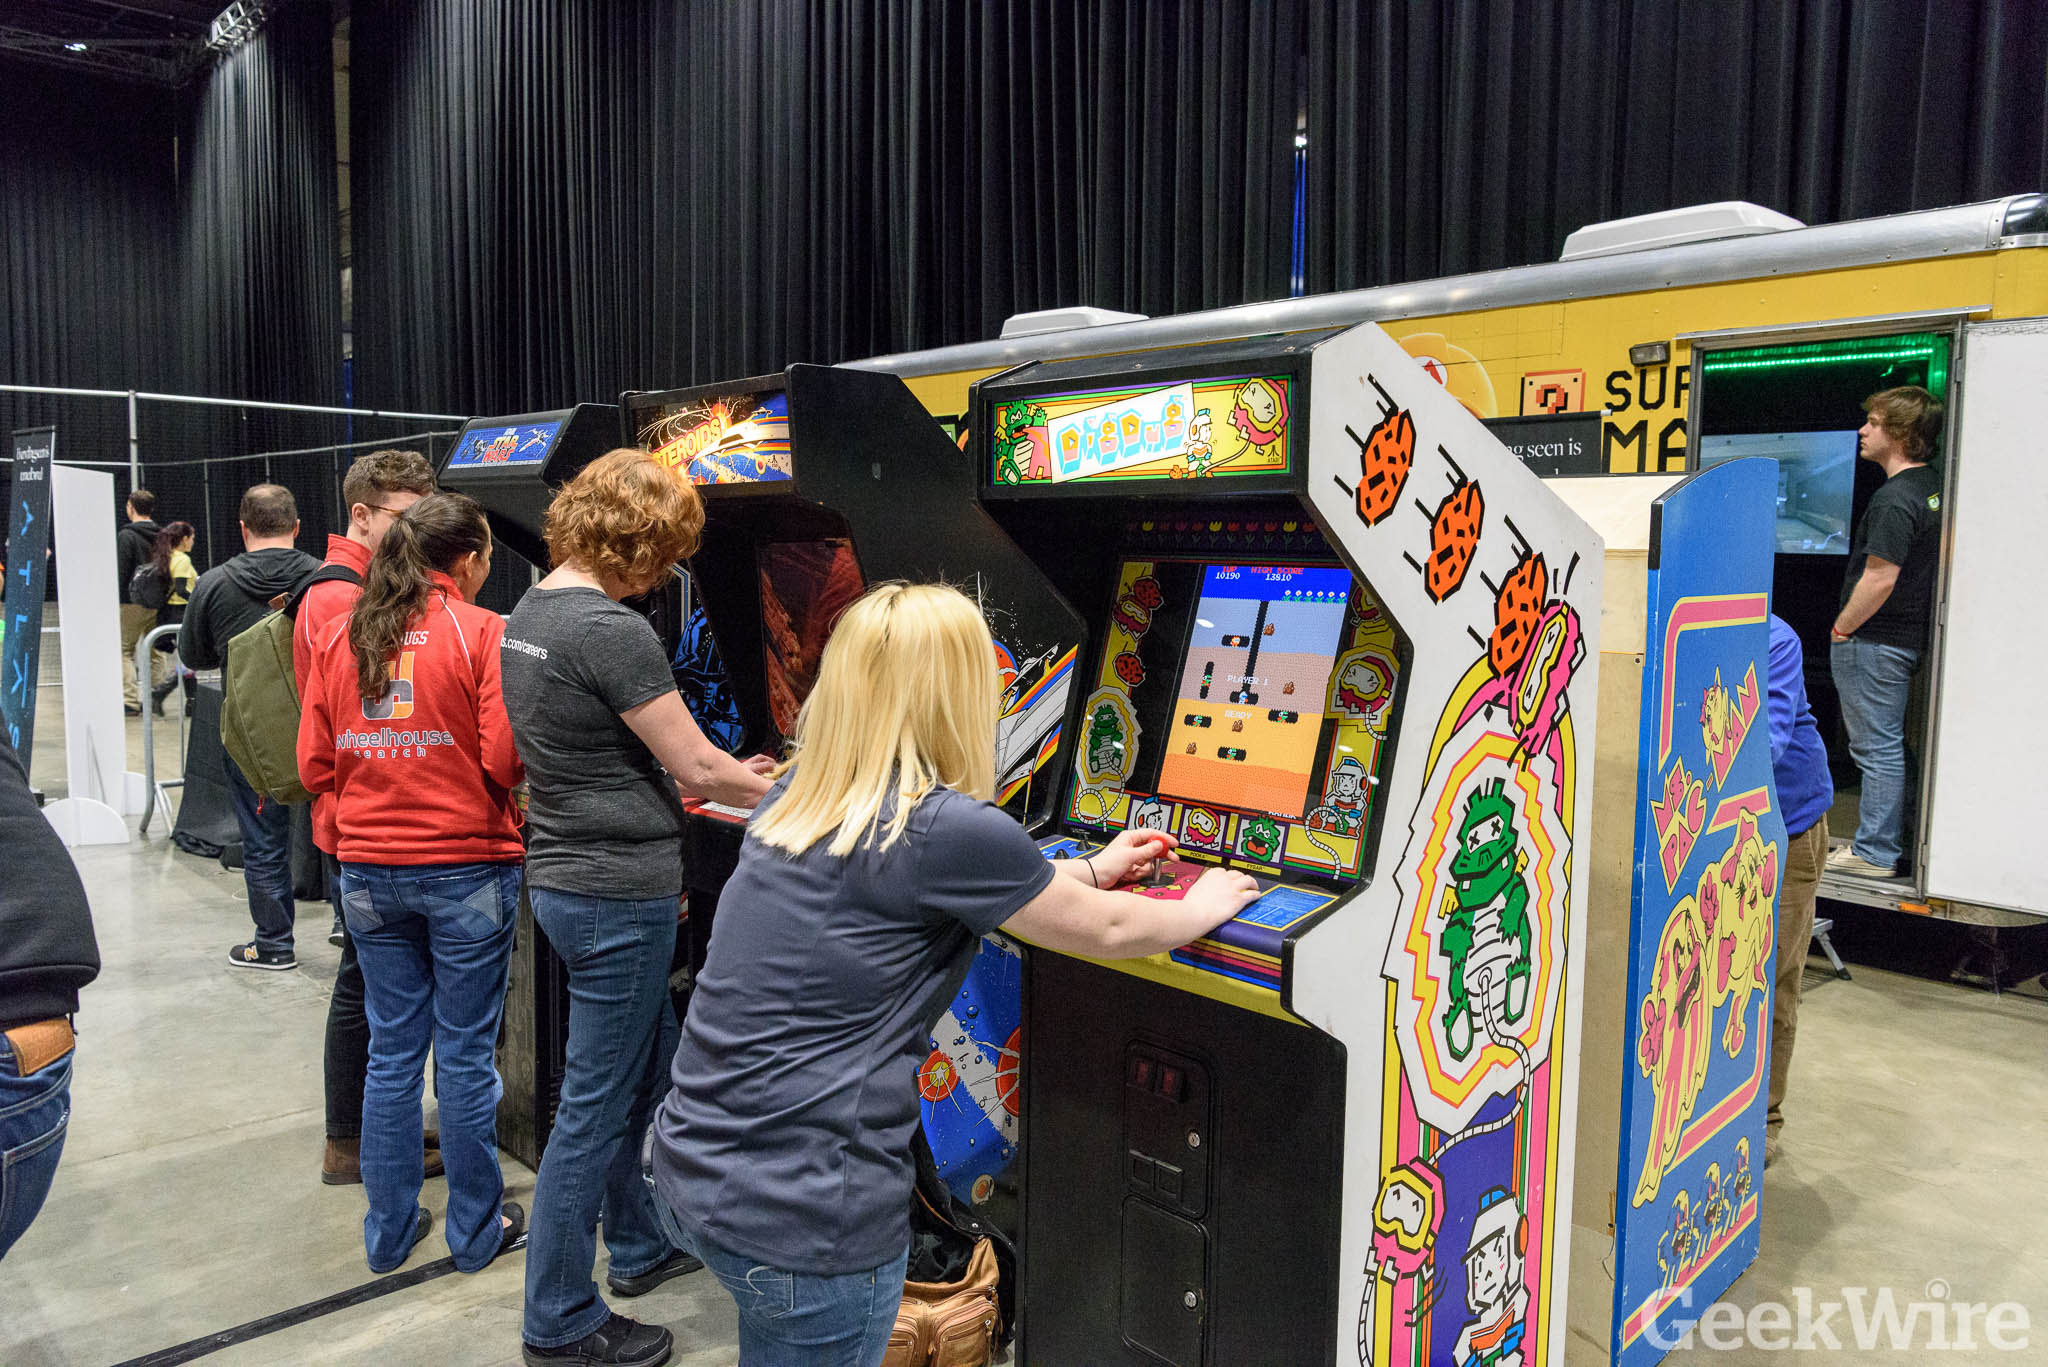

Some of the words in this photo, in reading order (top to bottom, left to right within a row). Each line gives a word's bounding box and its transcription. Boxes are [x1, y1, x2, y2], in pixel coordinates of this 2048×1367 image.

[488, 435, 519, 449] STAR
[1527, 443, 1564, 457] seen
[1568, 437, 1582, 456] is
[482, 449, 515, 463] WARS
[1215, 572, 1241, 580] 10190
[1222, 565, 1237, 573] 1UP
[1251, 566, 1276, 574] HIGH
[1277, 567, 1304, 575] SCORE
[400, 631, 429, 645] UGS
[1227, 674, 1260, 684] PLAYER
[1224, 710, 1252, 719] READY
[336, 728, 454, 749] wheelhouse
[354, 746, 426, 759] search
